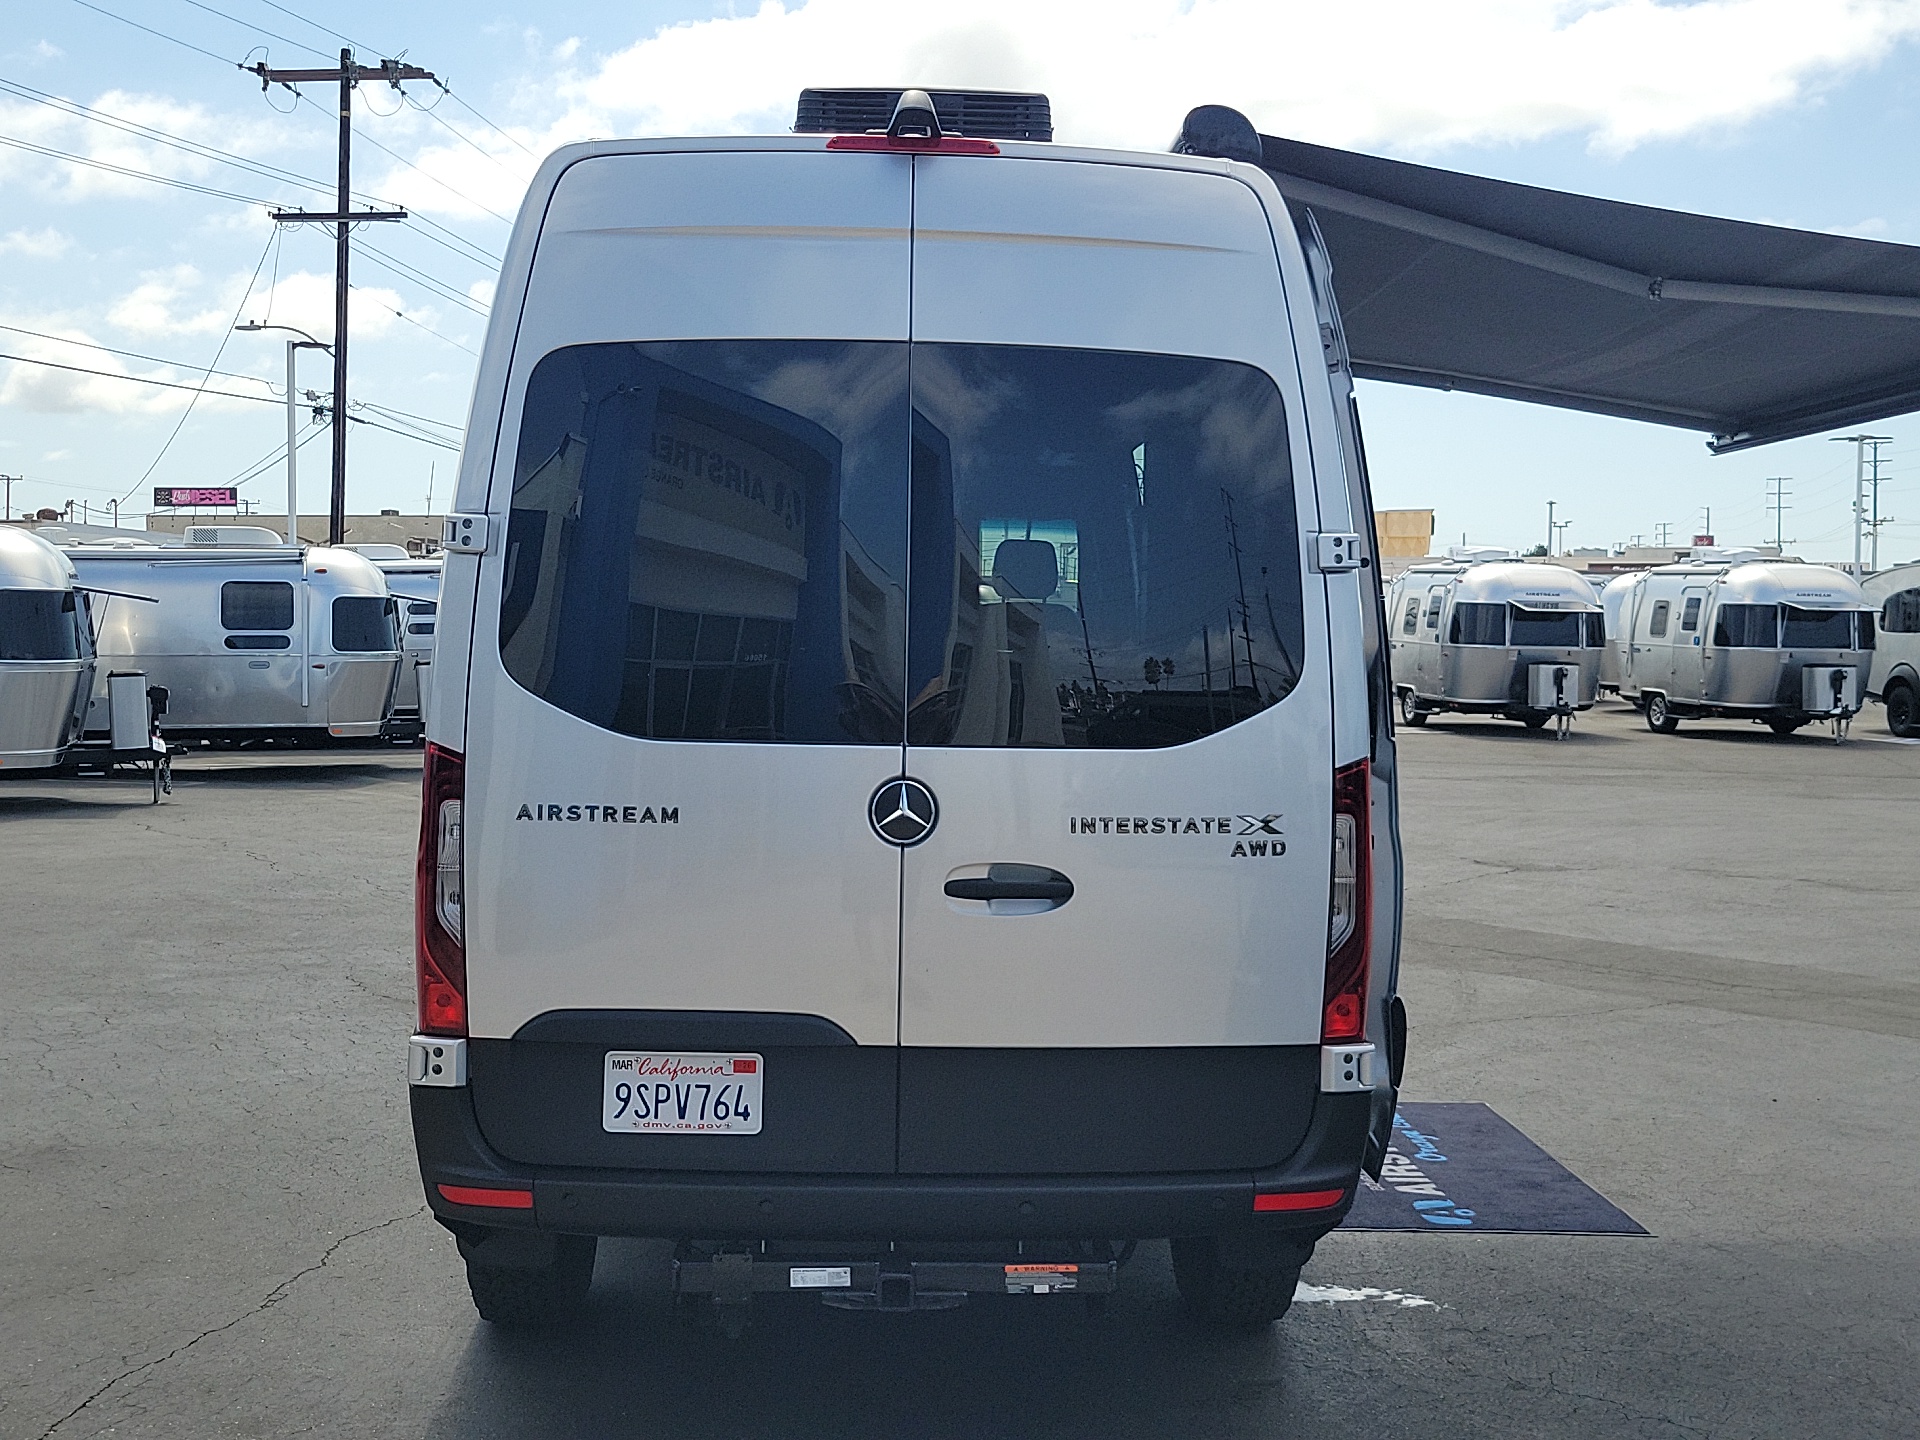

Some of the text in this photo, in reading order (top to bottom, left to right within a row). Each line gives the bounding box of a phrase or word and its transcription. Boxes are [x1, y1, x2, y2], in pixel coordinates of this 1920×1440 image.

[516, 803, 679, 824] AIRSTREAM
[1070, 817, 1232, 834] INTERSTATE
[1230, 840, 1287, 857] AWD
[612, 1059, 633, 1070] MAR
[638, 1057, 735, 1081] California
[613, 1083, 751, 1121] 9SPV764
[643, 1121, 723, 1130] dmv.ca.gov
